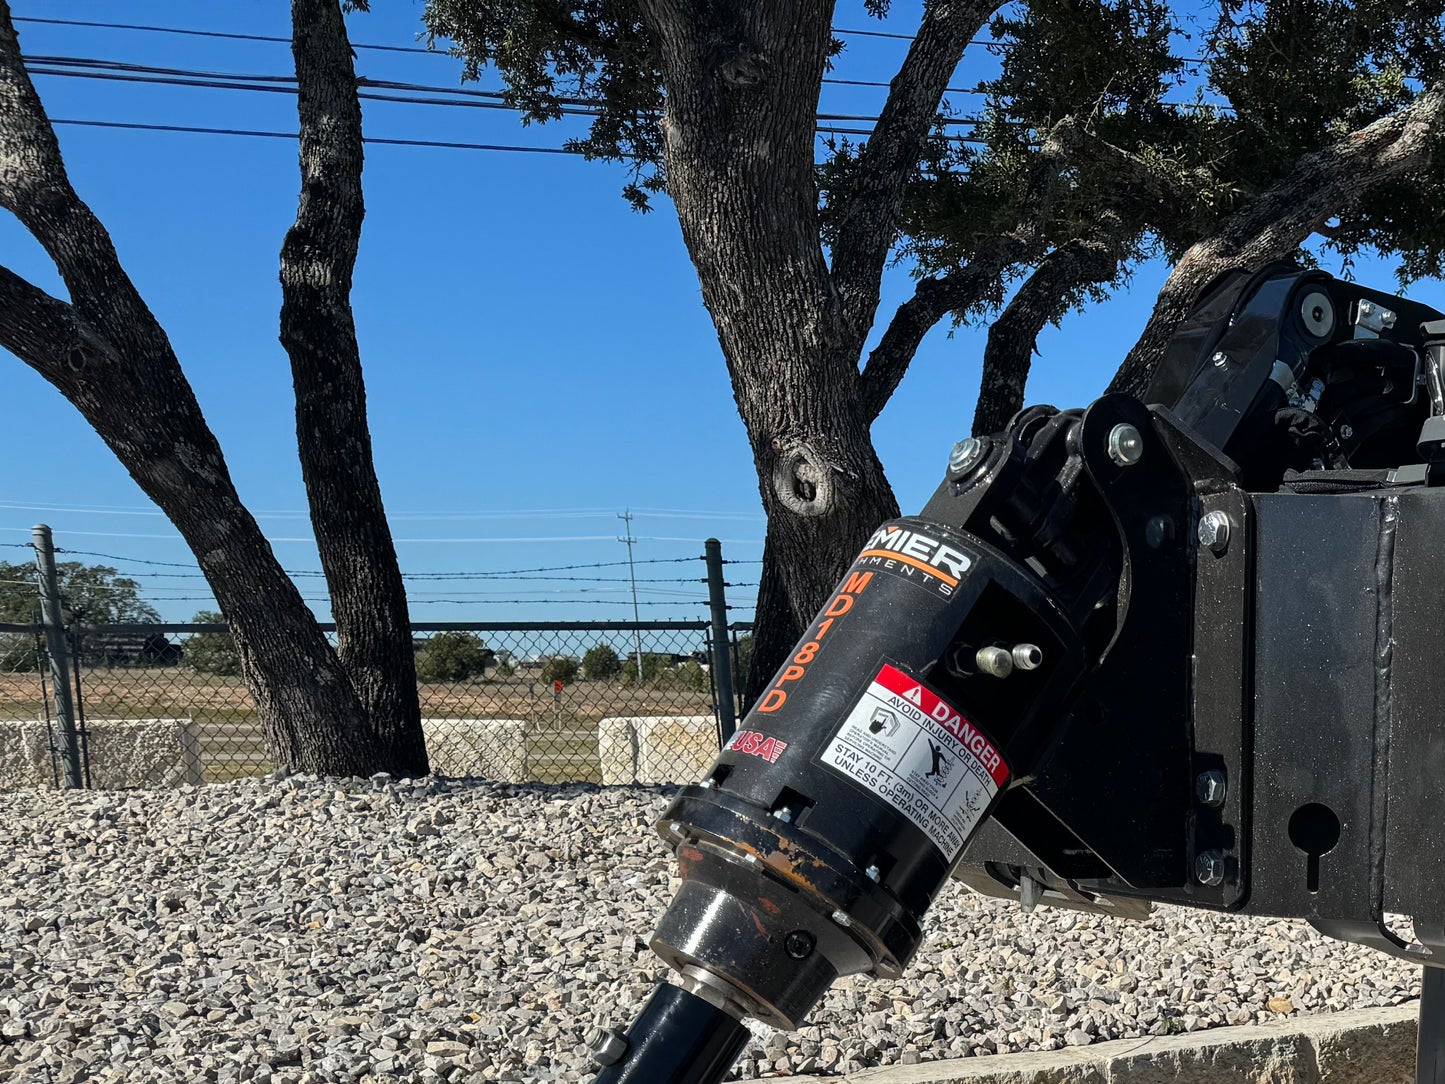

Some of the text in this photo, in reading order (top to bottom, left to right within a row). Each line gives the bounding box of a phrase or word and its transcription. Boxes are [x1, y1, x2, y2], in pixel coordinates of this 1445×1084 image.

[757, 571, 874, 712] MD18PD
[732, 730, 777, 762] USA
[888, 696, 992, 787] AVOID INJURY OR DEATH
[931, 701, 1001, 774] DANGER
[834, 743, 864, 764] STAY
[864, 761, 877, 774] 10
[877, 769, 893, 785] FT.
[893, 782, 914, 803] (3m)
[915, 798, 929, 814] OR
[927, 810, 950, 834] MORE
[946, 831, 961, 849] AWAY
[834, 755, 878, 787] UNLESS
[878, 784, 929, 829] OPERATING
[928, 826, 954, 857] MACHINE
